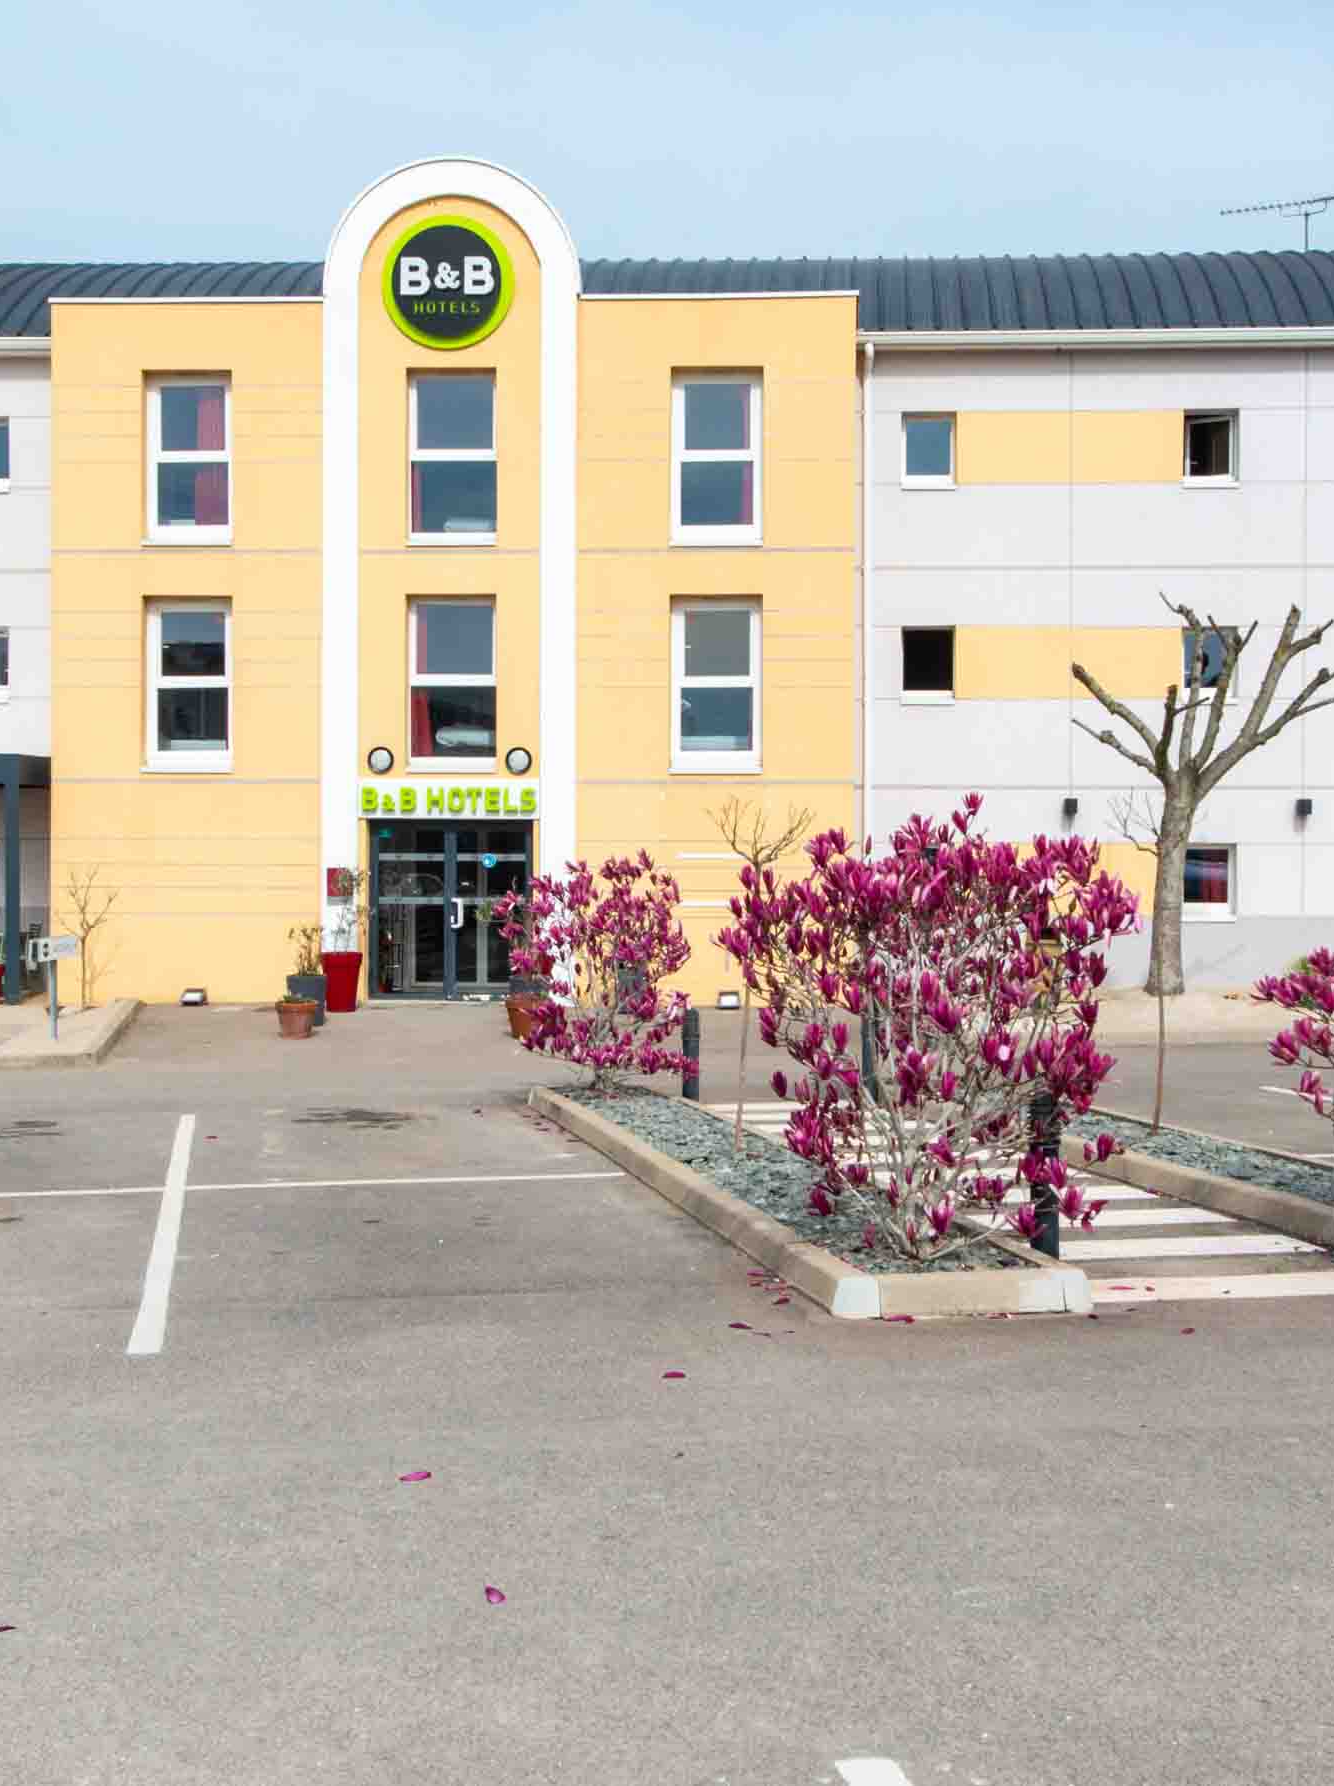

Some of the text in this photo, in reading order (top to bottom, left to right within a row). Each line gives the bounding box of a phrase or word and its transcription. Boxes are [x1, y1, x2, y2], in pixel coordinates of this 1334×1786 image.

[400, 256, 495, 295] B&B
[412, 301, 481, 313] HOTELS
[361, 786, 537, 814] B&B HOTELS
